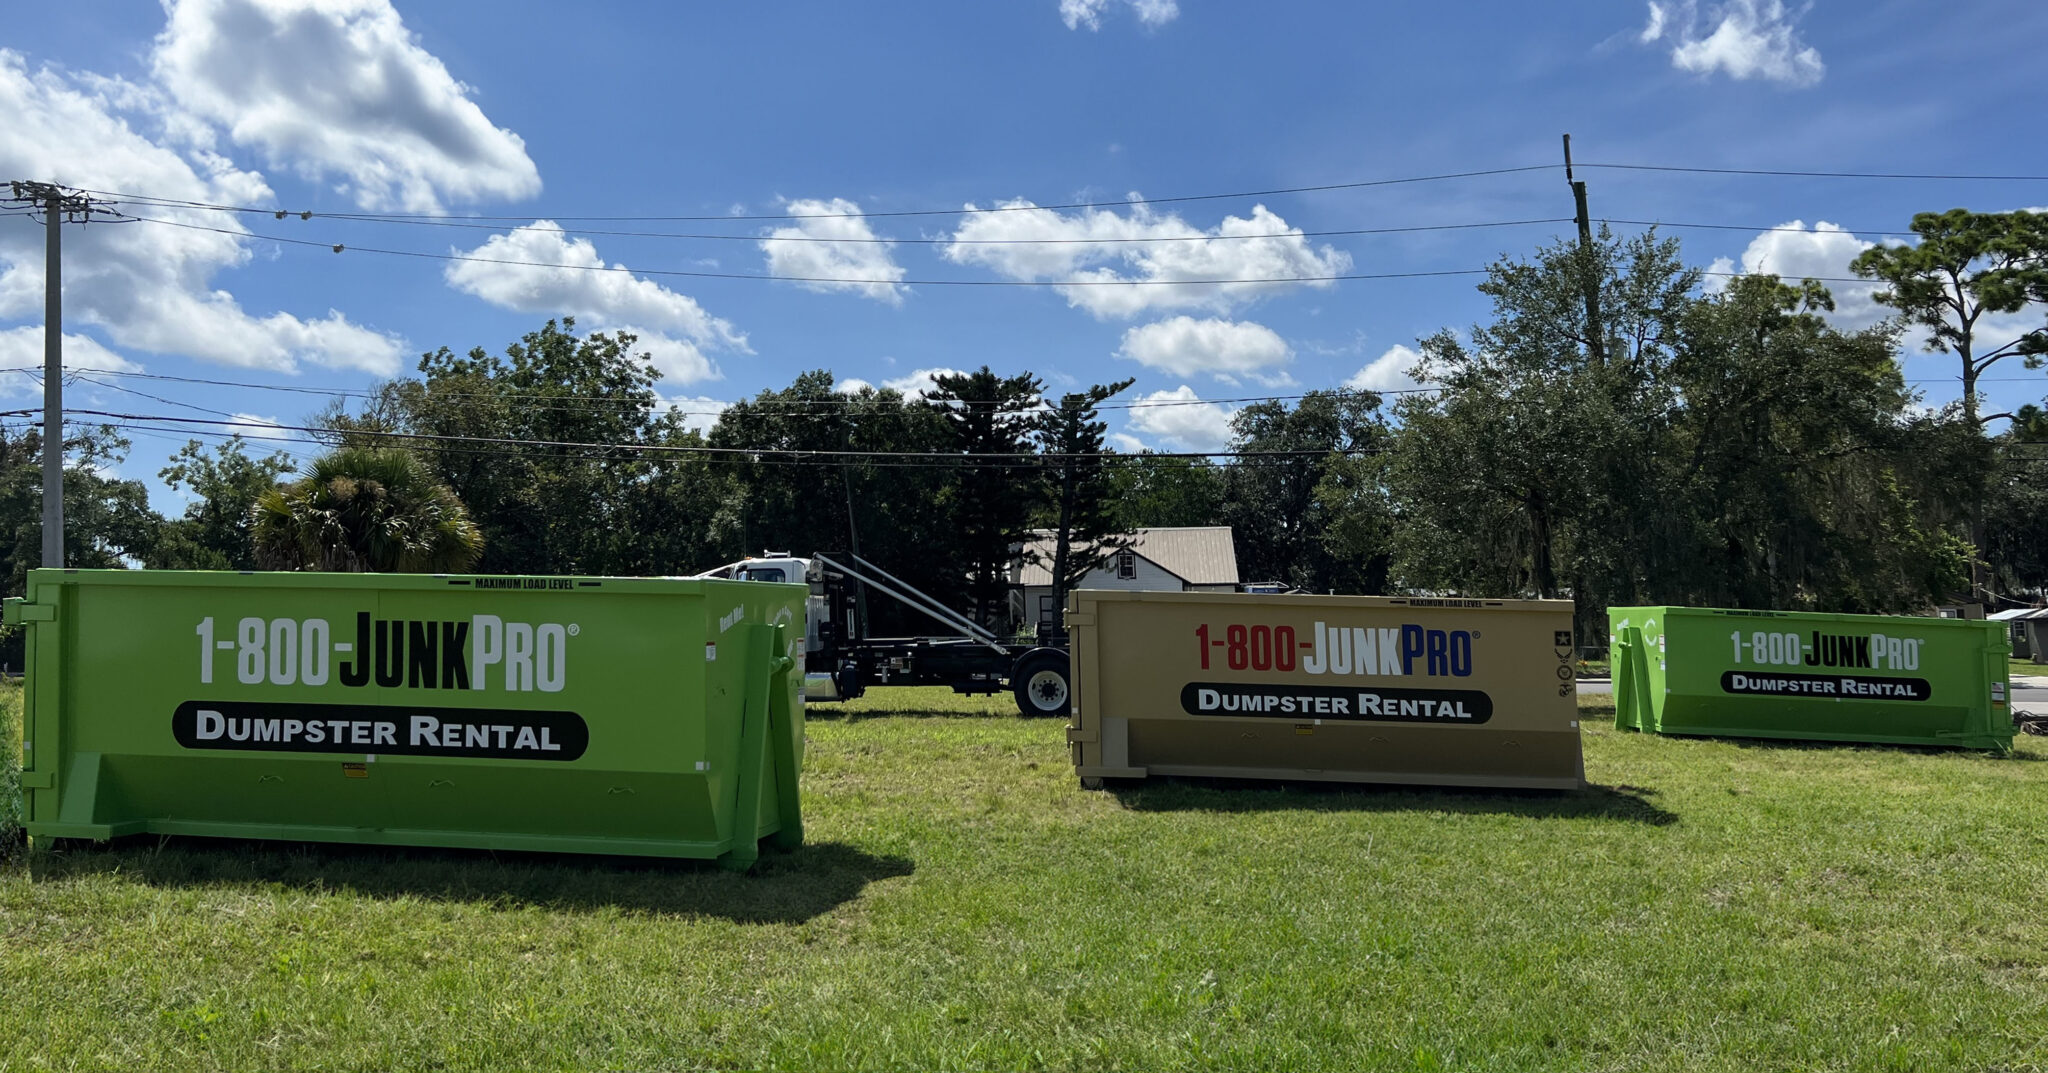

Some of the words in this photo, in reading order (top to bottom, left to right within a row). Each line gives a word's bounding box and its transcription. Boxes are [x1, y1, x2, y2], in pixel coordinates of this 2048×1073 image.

[475, 578, 521, 589] MAXIMUM
[523, 579, 547, 590] LOAD
[549, 579, 574, 590] LEVEL
[1731, 674, 1836, 694] DUMPSTER
[1841, 678, 1918, 697] RENTAL
[1198, 688, 1350, 715] DUMPSTER
[1357, 692, 1473, 719] RENTAL
[196, 710, 398, 746] DUMPSTER
[409, 715, 561, 752] RENTAL
